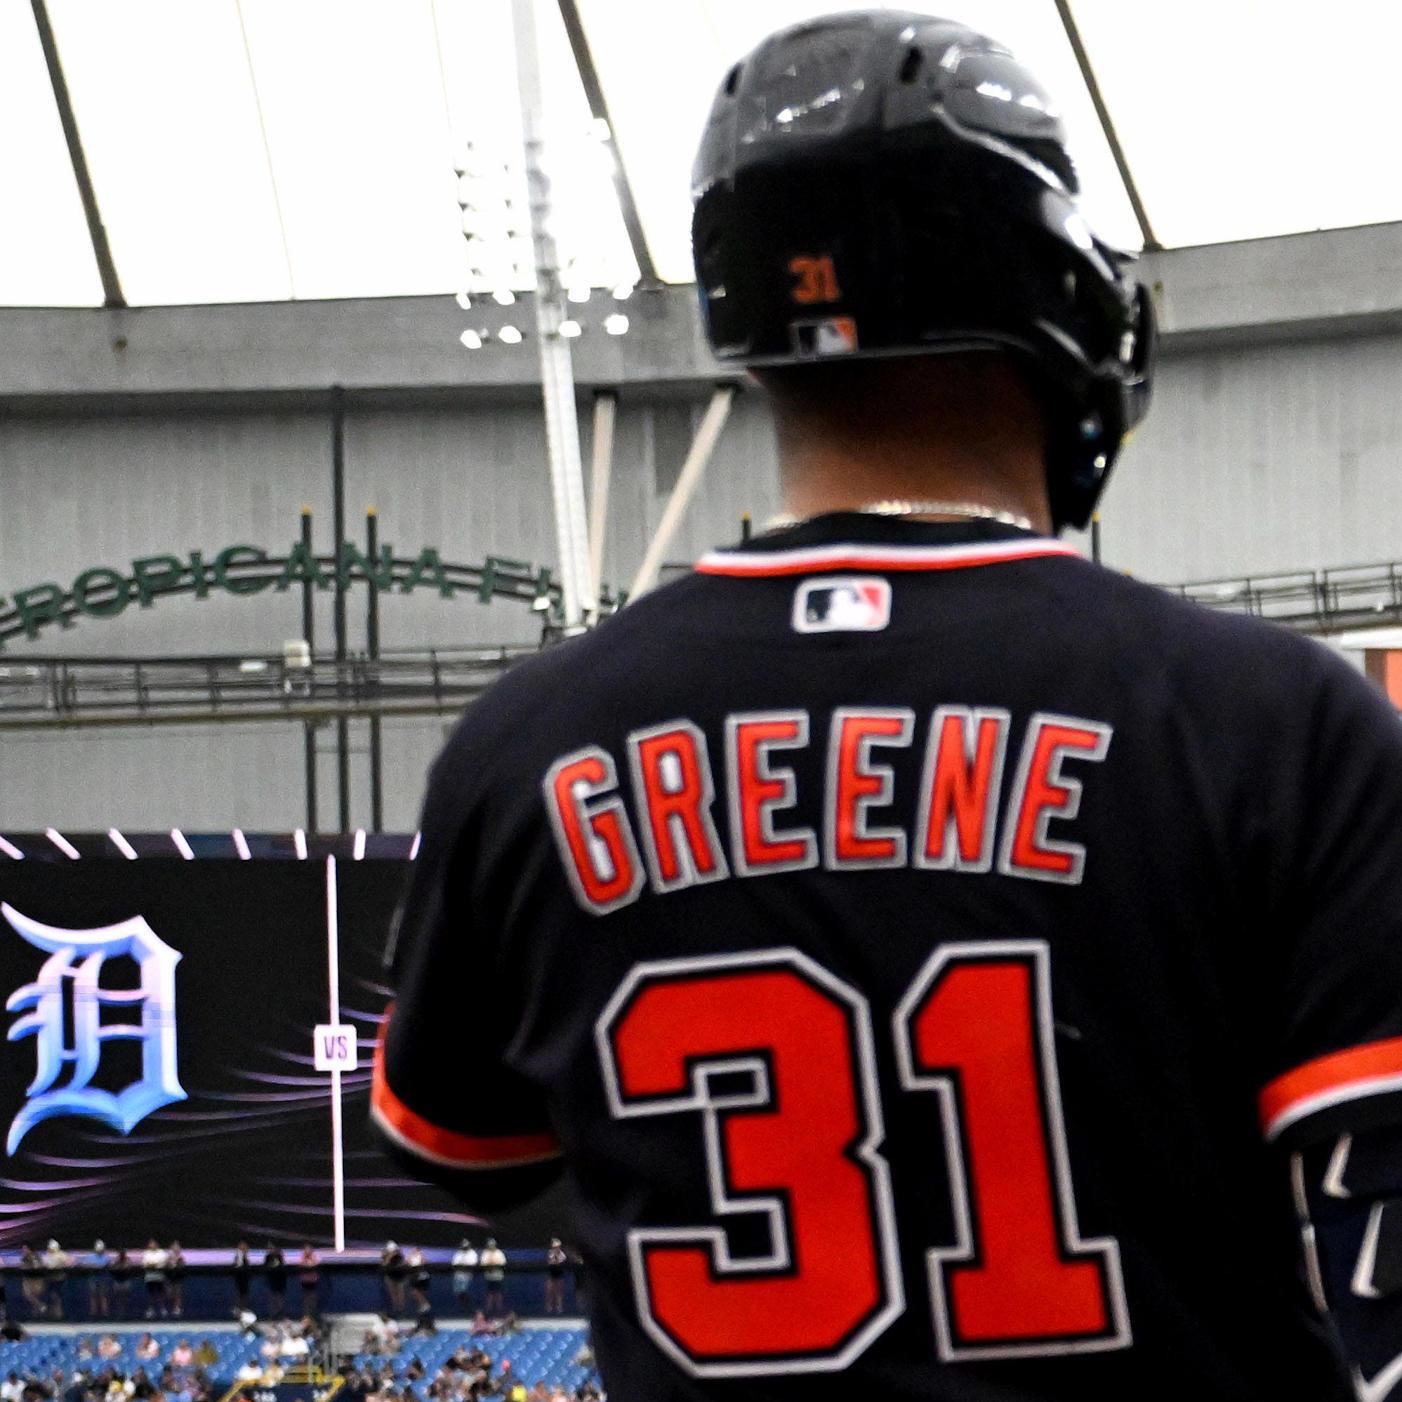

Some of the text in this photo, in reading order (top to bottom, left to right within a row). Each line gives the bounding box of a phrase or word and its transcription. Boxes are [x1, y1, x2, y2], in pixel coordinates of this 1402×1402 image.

[788, 255, 841, 303] 31
[543, 706, 1113, 916] GREENE
[323, 1035, 348, 1060] VS
[597, 941, 1132, 1379] 31
